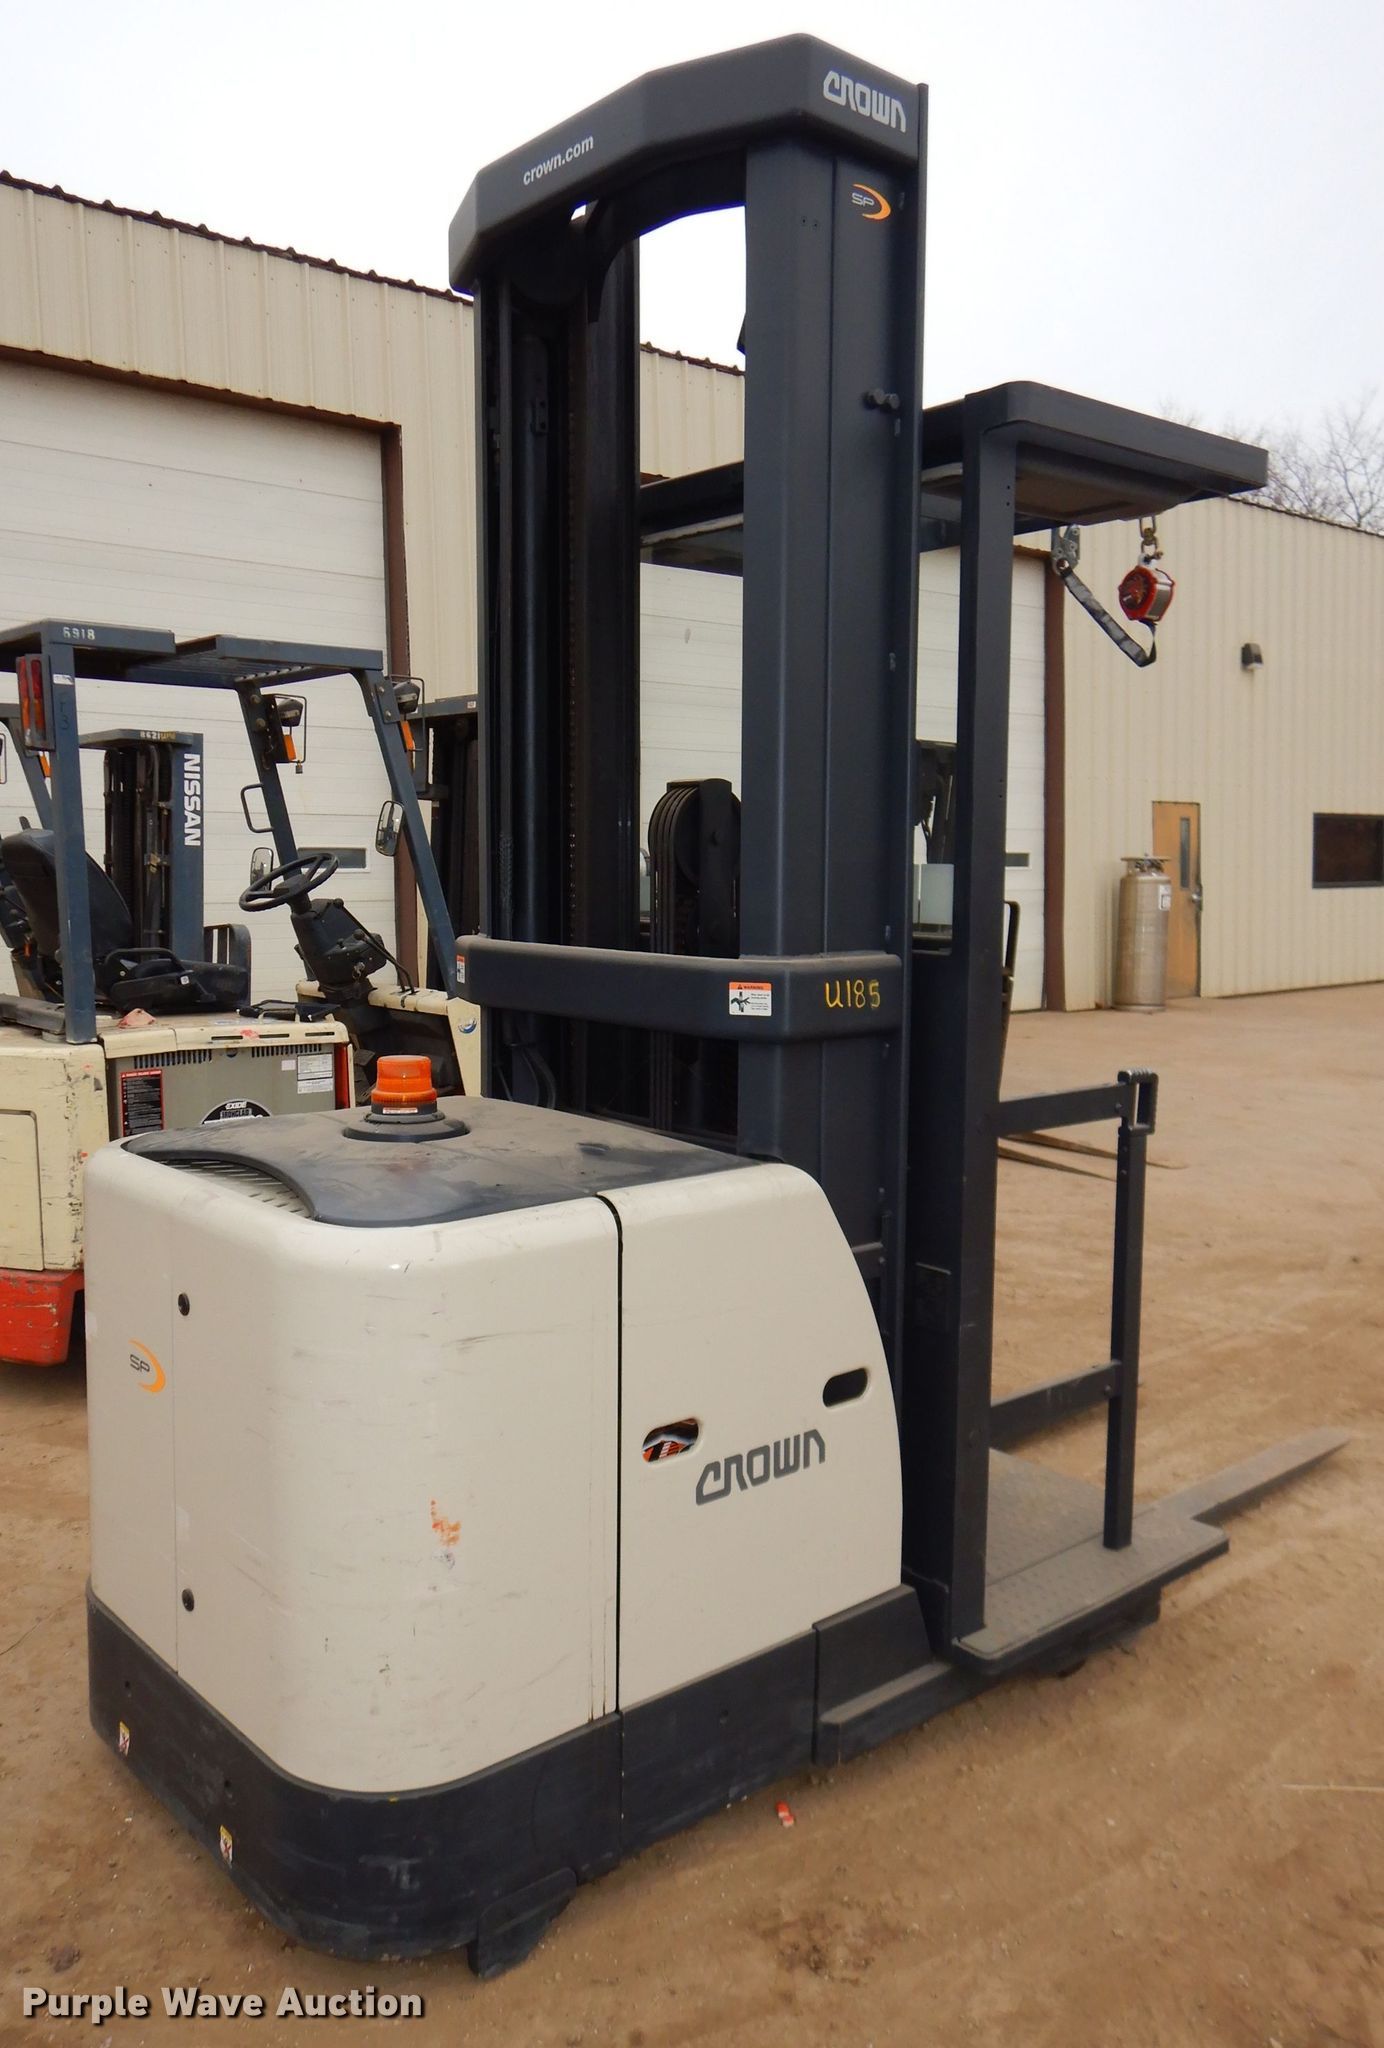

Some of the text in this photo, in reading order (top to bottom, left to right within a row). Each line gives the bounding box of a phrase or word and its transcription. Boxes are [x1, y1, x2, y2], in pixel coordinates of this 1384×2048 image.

[823, 70, 907, 133] CROWN
[523, 135, 594, 186] crown.com
[852, 192, 875, 207] SP
[184, 753, 200, 846] NISSAN
[825, 979, 881, 1009] U185
[130, 1354, 150, 1372] SP
[696, 1429, 826, 1506] CROWN
